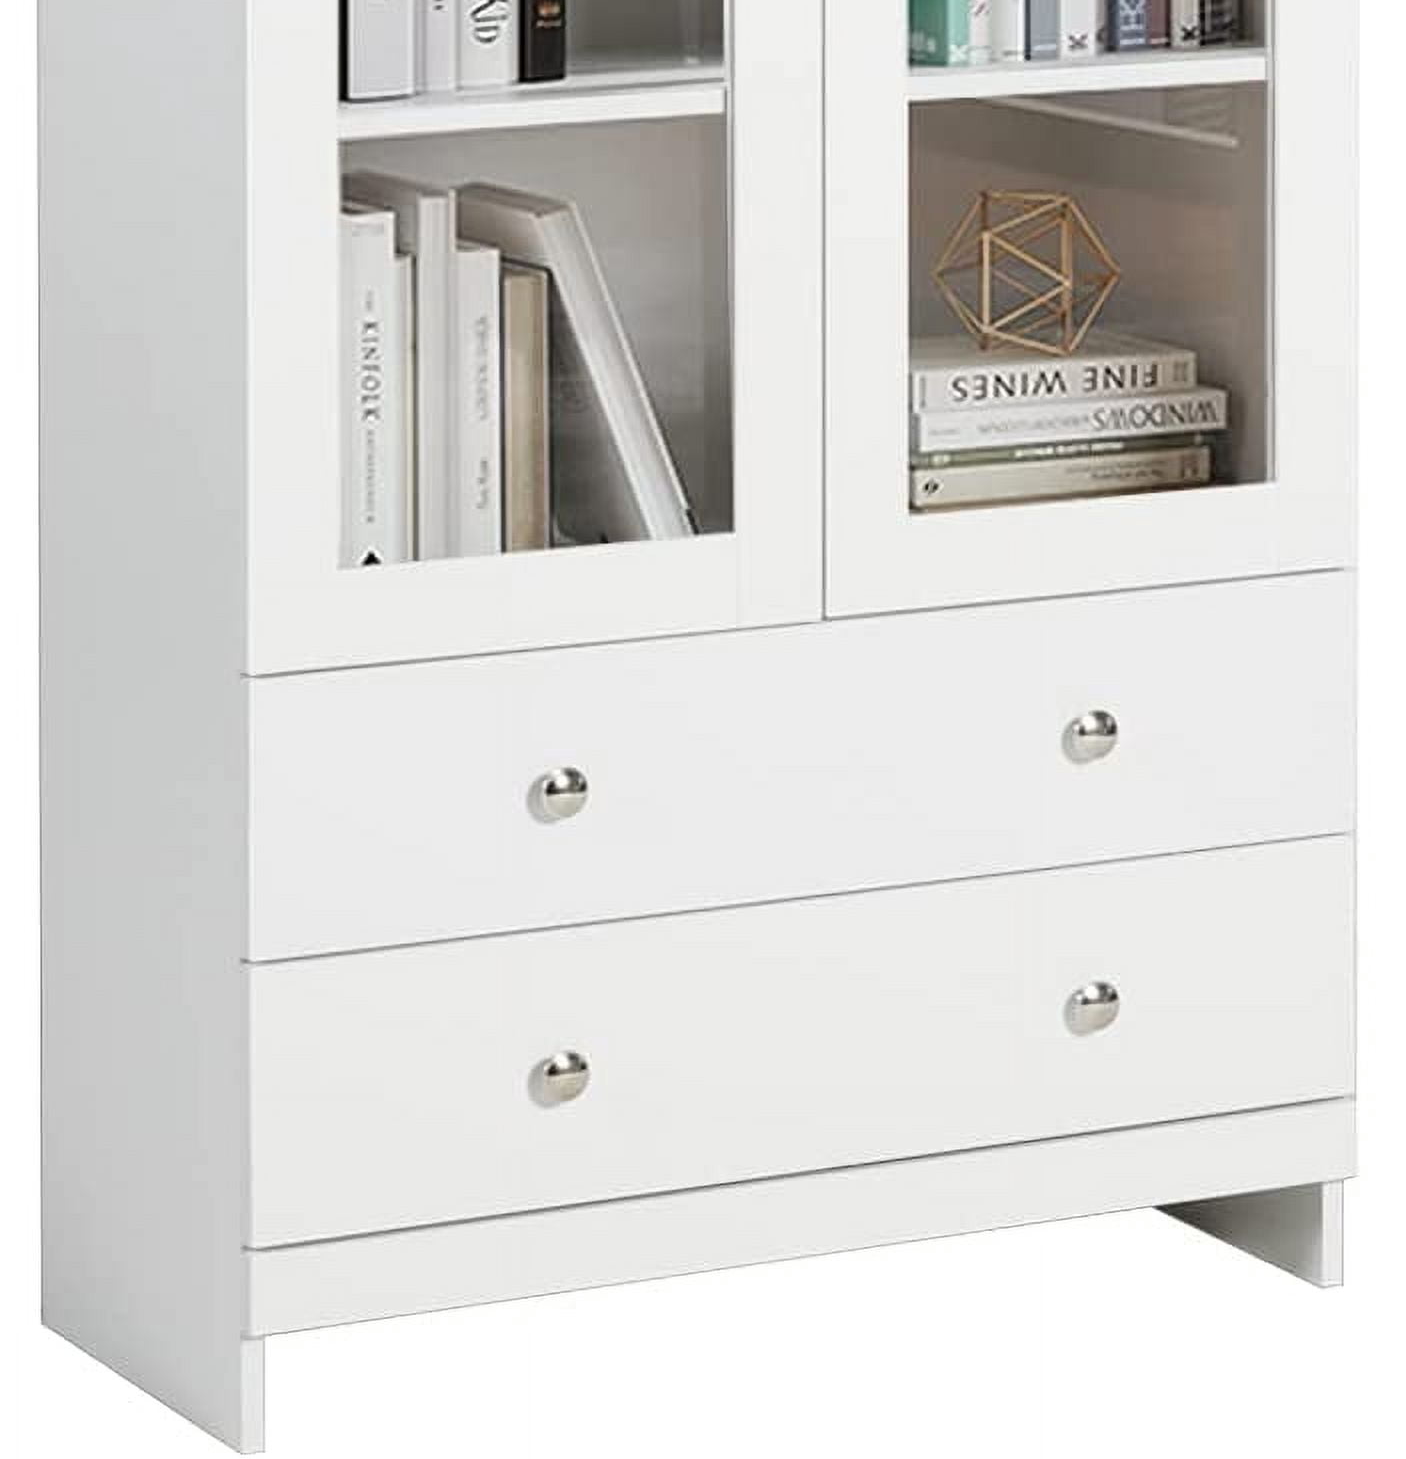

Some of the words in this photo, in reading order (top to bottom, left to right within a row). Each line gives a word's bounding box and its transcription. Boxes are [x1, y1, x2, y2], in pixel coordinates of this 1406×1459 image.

[360, 320, 381, 422] KINFOLK
[951, 369, 1066, 402] WINES
[1082, 363, 1159, 393] FINE
[1089, 399, 1218, 432] WINDOWS
